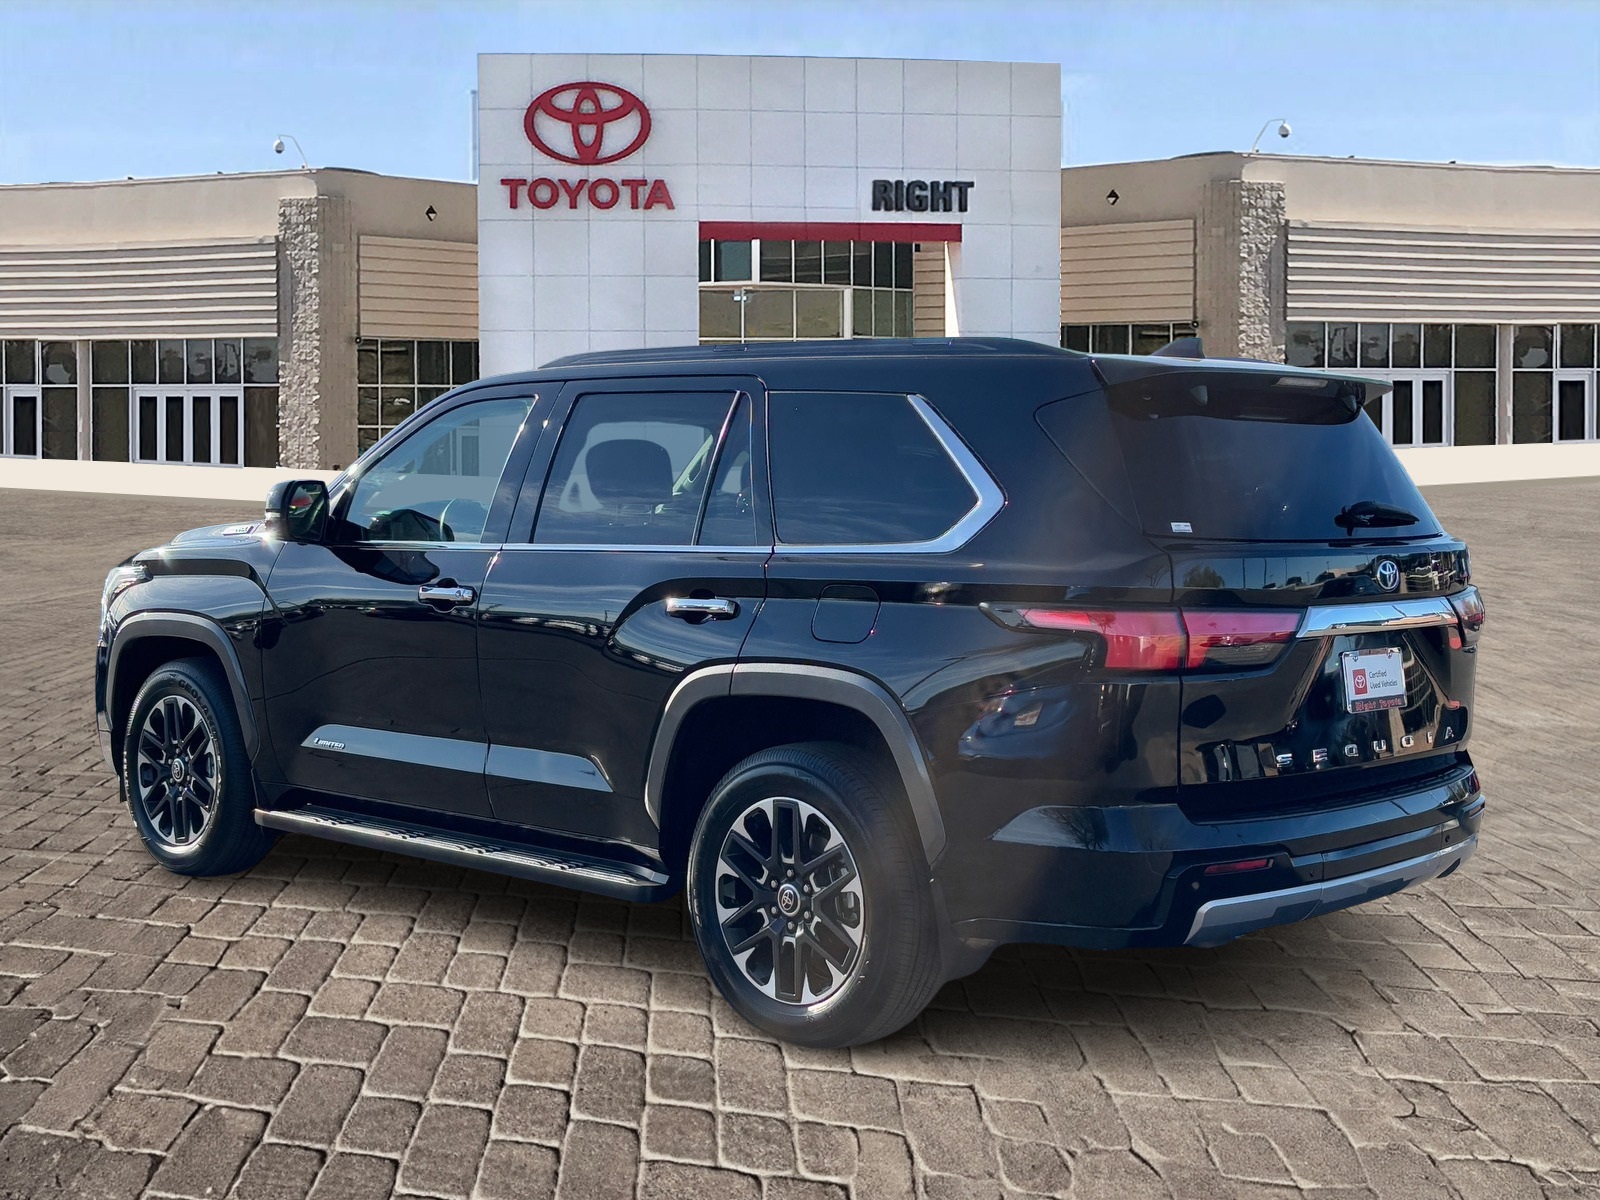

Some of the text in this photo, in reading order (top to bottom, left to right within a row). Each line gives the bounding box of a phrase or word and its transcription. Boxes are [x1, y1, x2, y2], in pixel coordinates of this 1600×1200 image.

[500, 178, 675, 210] TOYOTA
[871, 179, 975, 213] RIGHT
[1368, 669, 1387, 679] Certified
[1370, 680, 1398, 690] Used Vehicles
[1276, 726, 1455, 768] SEQUOIA
